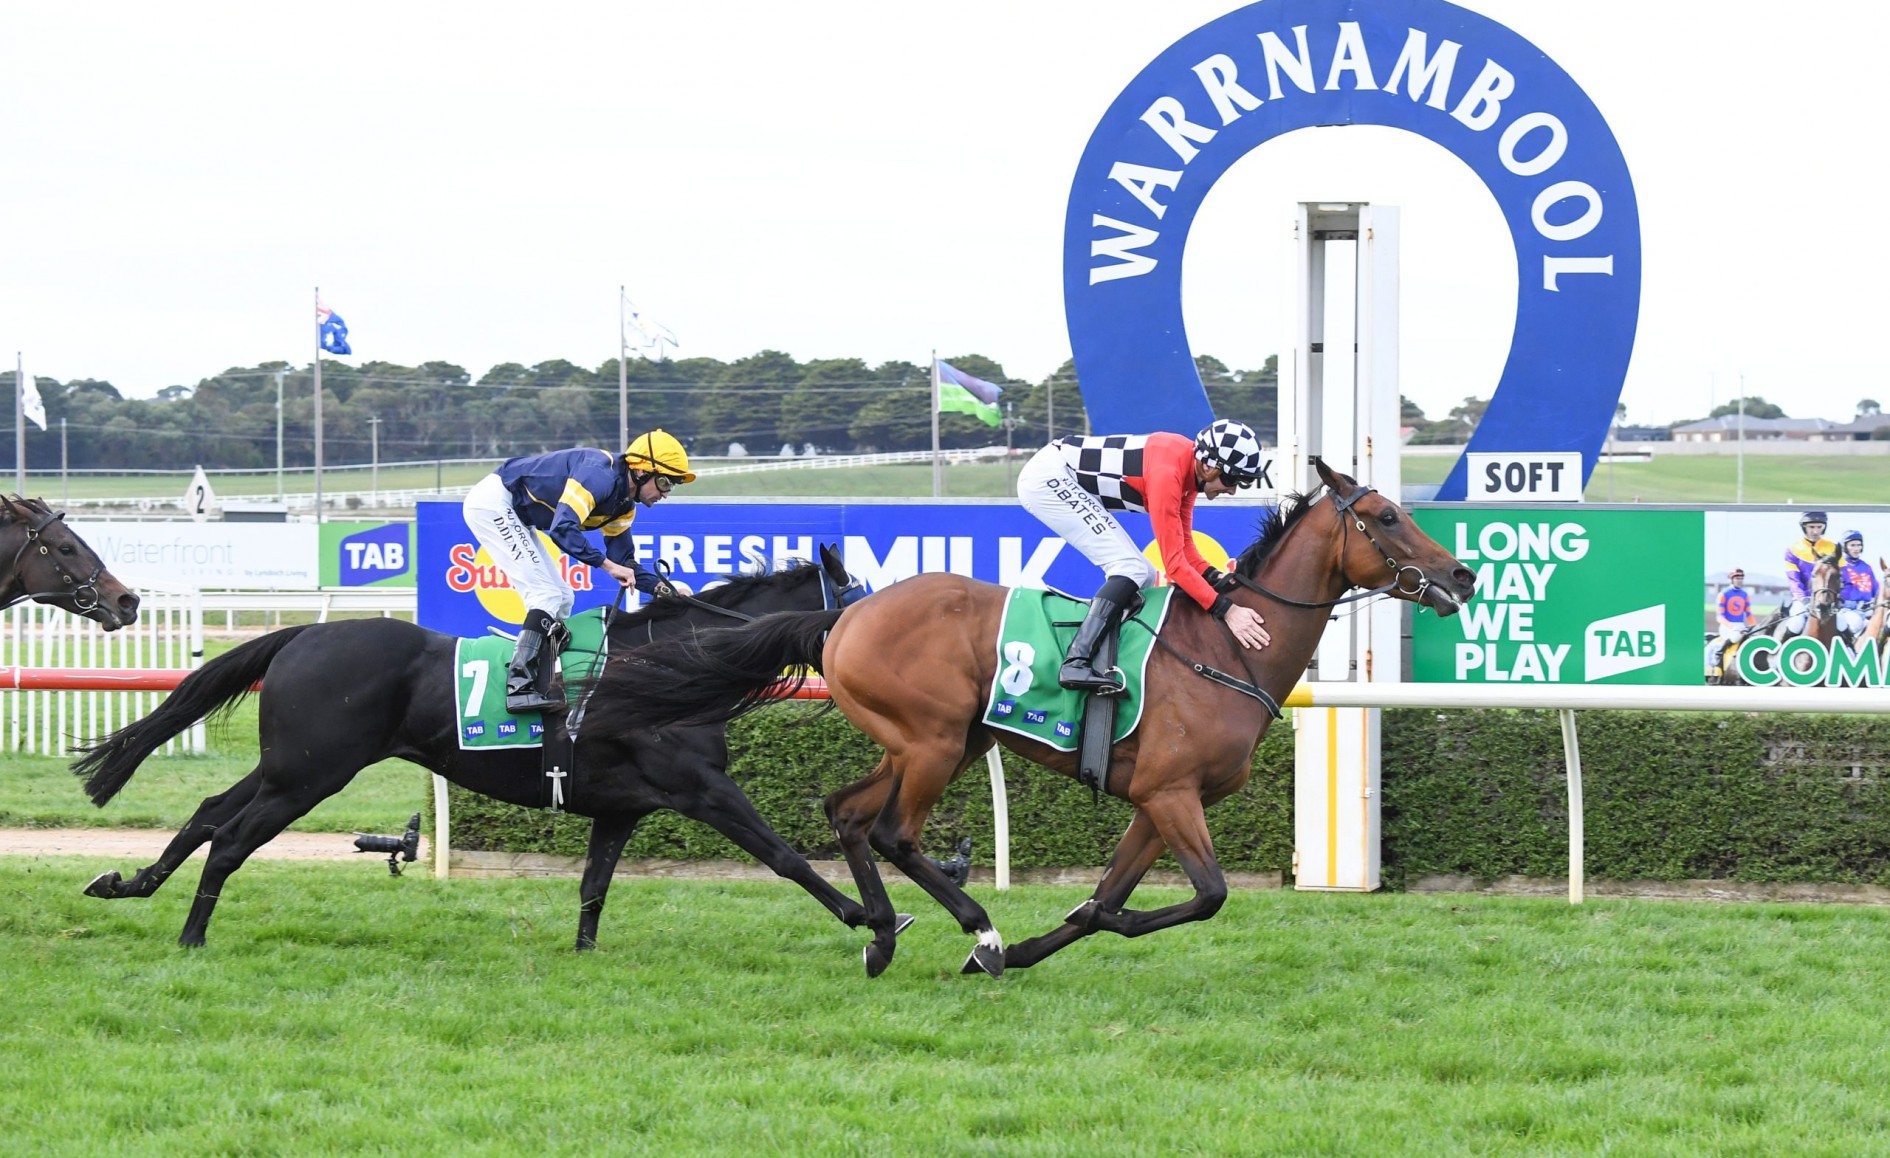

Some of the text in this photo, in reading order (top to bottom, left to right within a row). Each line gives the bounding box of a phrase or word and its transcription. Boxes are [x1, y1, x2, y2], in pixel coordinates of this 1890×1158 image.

[1089, 21, 1614, 292] WARRNAMBOOL
[1485, 461, 1564, 493] SOFT
[196, 485, 205, 514] 2
[1046, 478, 1107, 535] D.BATES
[96, 536, 233, 565] Waterfront
[344, 542, 405, 571] TAB
[631, 535, 813, 574] FRESH
[1455, 521, 1590, 562] LONG
[1461, 562, 1558, 601] MAY
[1458, 602, 1535, 641] WE
[1455, 642, 1572, 682] PLAY
[1593, 630, 1657, 658] TAB
[1737, 636, 1890, 688] COM
[1000, 640, 1036, 697] 8
[462, 659, 489, 718] 7
[997, 703, 1012, 714] TAB
[1027, 712, 1045, 723] TAB
[466, 726, 484, 735] TAB
[498, 725, 516, 733] TAB
[1057, 722, 1071, 736] TAB
